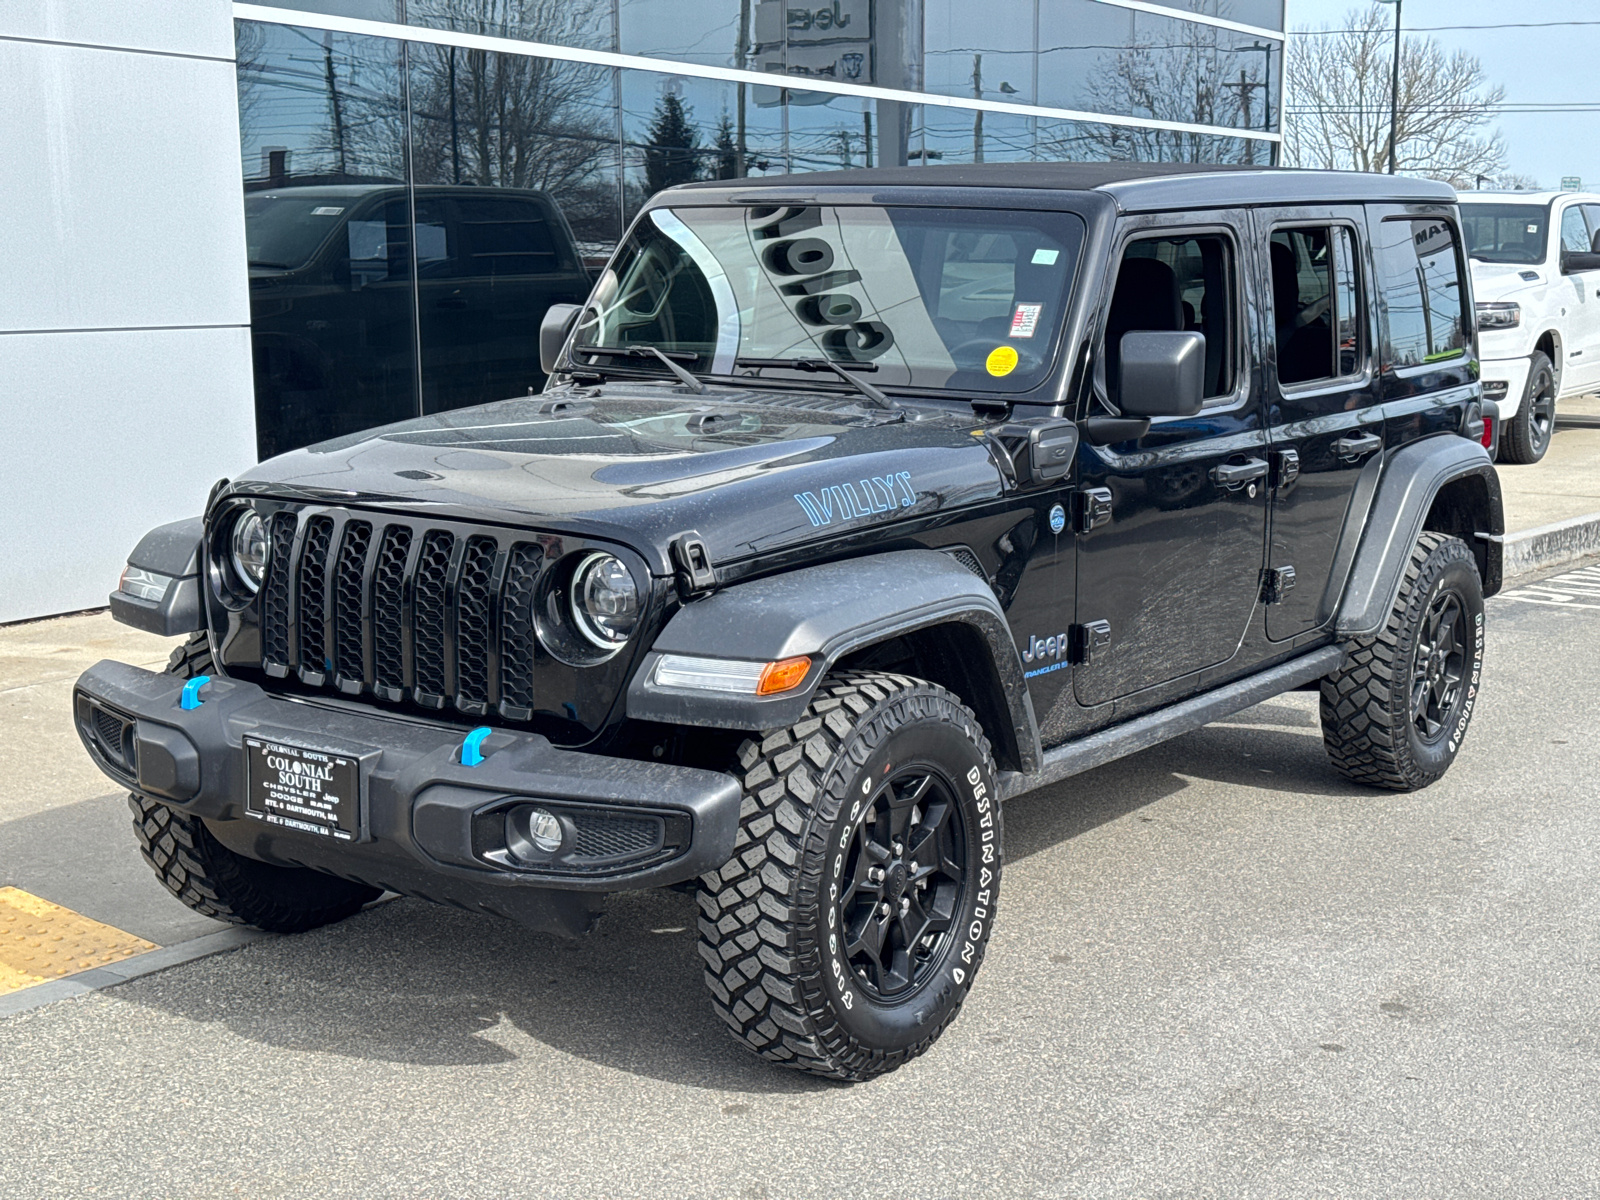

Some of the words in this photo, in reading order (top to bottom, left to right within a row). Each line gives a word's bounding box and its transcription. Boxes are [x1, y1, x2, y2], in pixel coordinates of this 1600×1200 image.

[794, 471, 916, 527] WILLYS
[1022, 633, 1068, 663] Jeep
[1453, 612, 1483, 744] DESTINATION
[266, 743, 300, 756] COLONIAL
[303, 751, 328, 762] SOUTH
[267, 755, 333, 780] COLONIAL
[263, 781, 317, 798] CHRYSLER
[322, 792, 340, 804] Jeep
[279, 770, 322, 792] SOUTH
[270, 790, 304, 804] DODGE
[310, 800, 332, 810] RAM
[327, 812, 338, 821] MA
[320, 827, 330, 835] MA
[962, 765, 995, 965] DESTINATION
